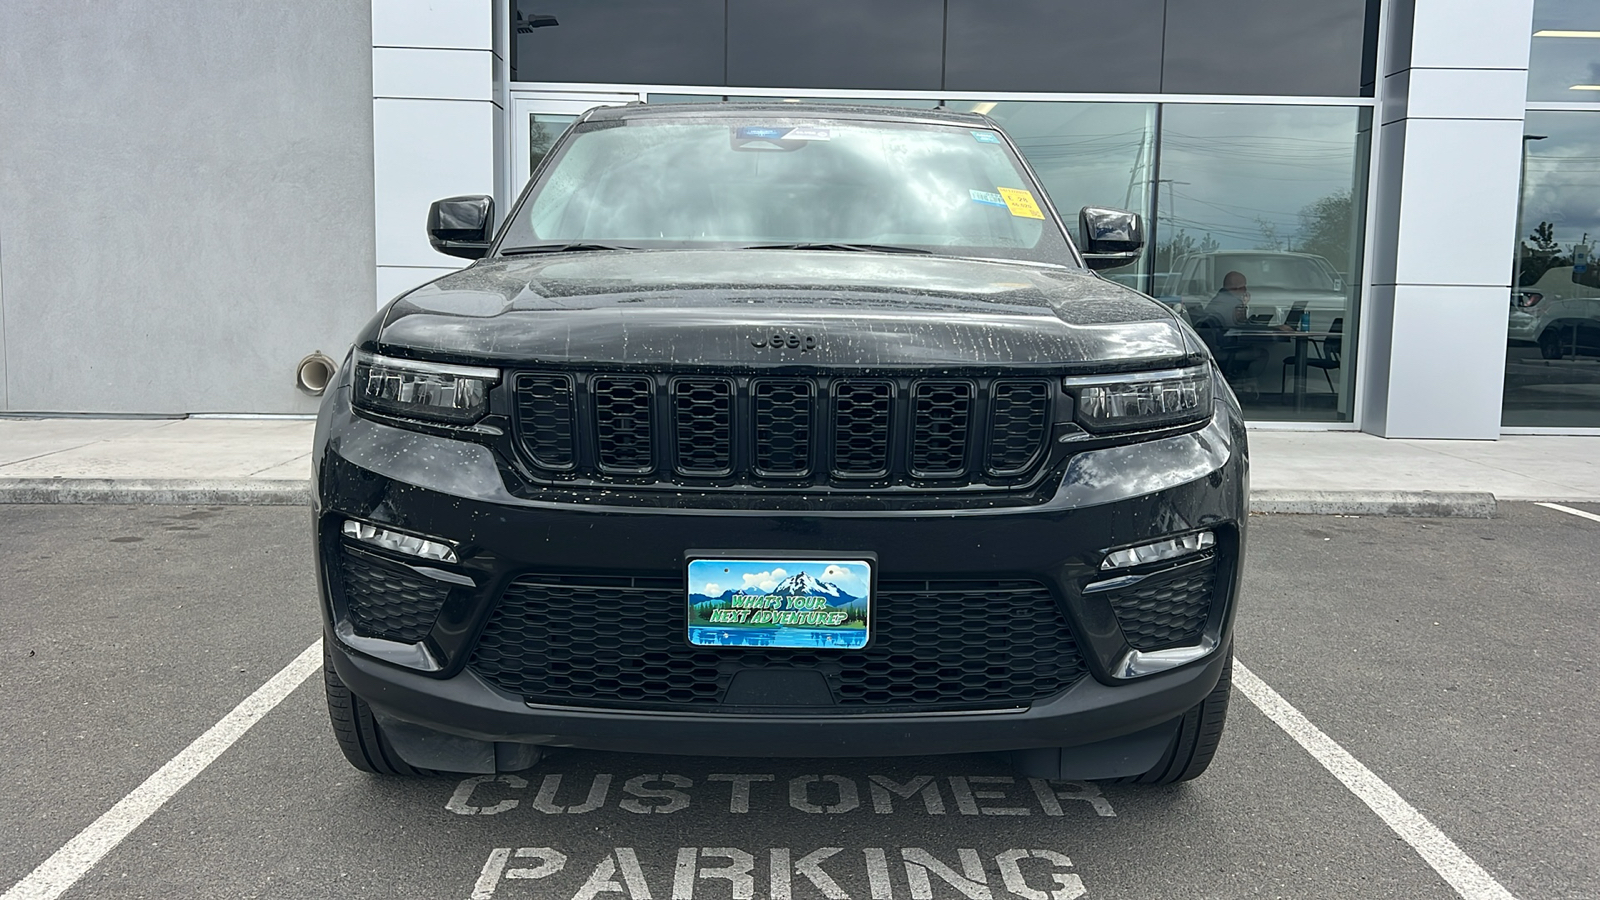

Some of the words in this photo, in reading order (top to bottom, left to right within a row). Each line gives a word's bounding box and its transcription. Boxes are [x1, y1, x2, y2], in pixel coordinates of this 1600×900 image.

[751, 333, 817, 352] Jeep
[731, 595, 783, 609] WHAT'S
[786, 596, 826, 610] YOUR
[709, 609, 751, 624] NEXT
[750, 611, 848, 626] ADVENTURE?
[445, 773, 1117, 816] CUSTOMER
[471, 847, 1087, 900] PARKING
